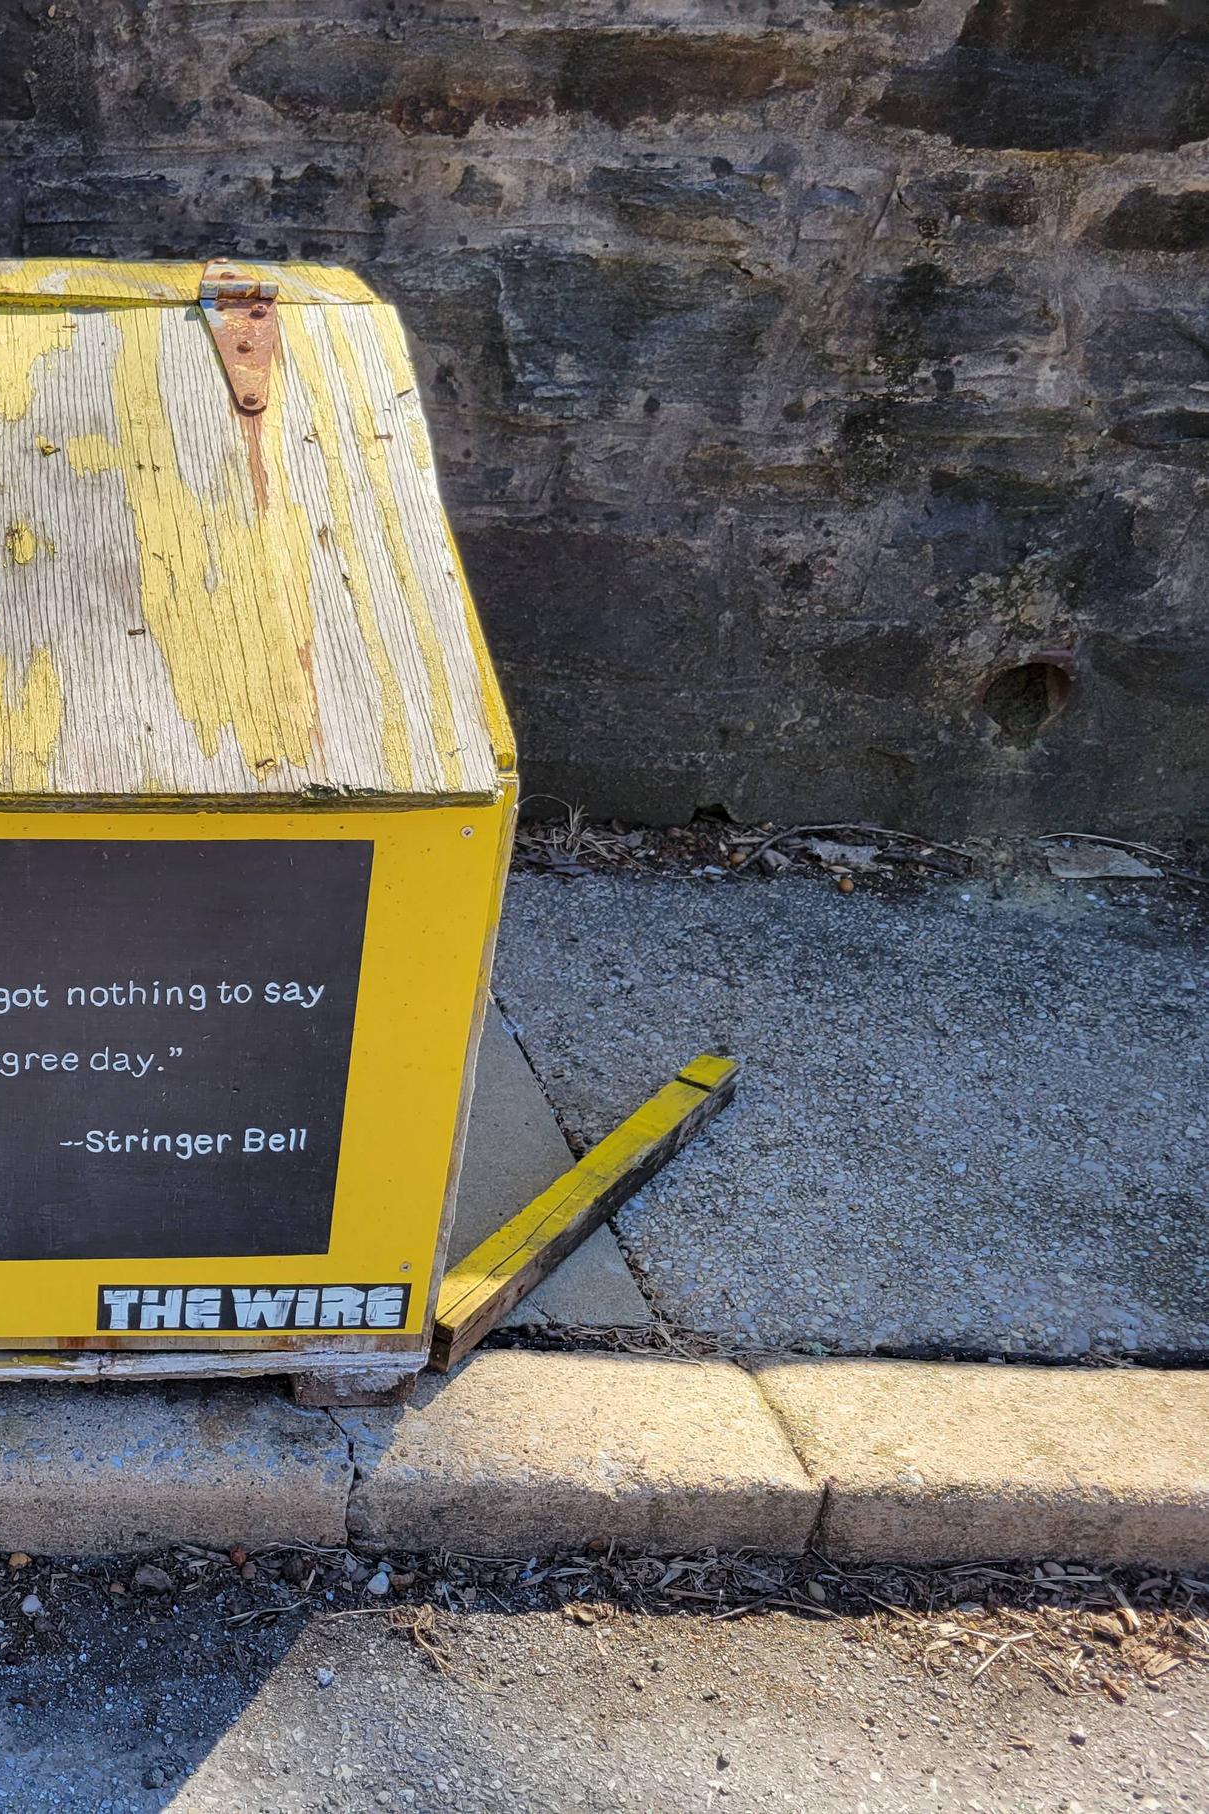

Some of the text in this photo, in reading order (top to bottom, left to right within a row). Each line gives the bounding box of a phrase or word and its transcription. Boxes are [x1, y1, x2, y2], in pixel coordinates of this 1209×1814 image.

[67, 980, 207, 1011] nothing
[216, 981, 253, 1004] to
[263, 981, 325, 1009] say
[89, 1046, 183, 1078] day.”
[242, 1127, 308, 1153] Bell
[103, 1286, 404, 1329] THE WIRE
